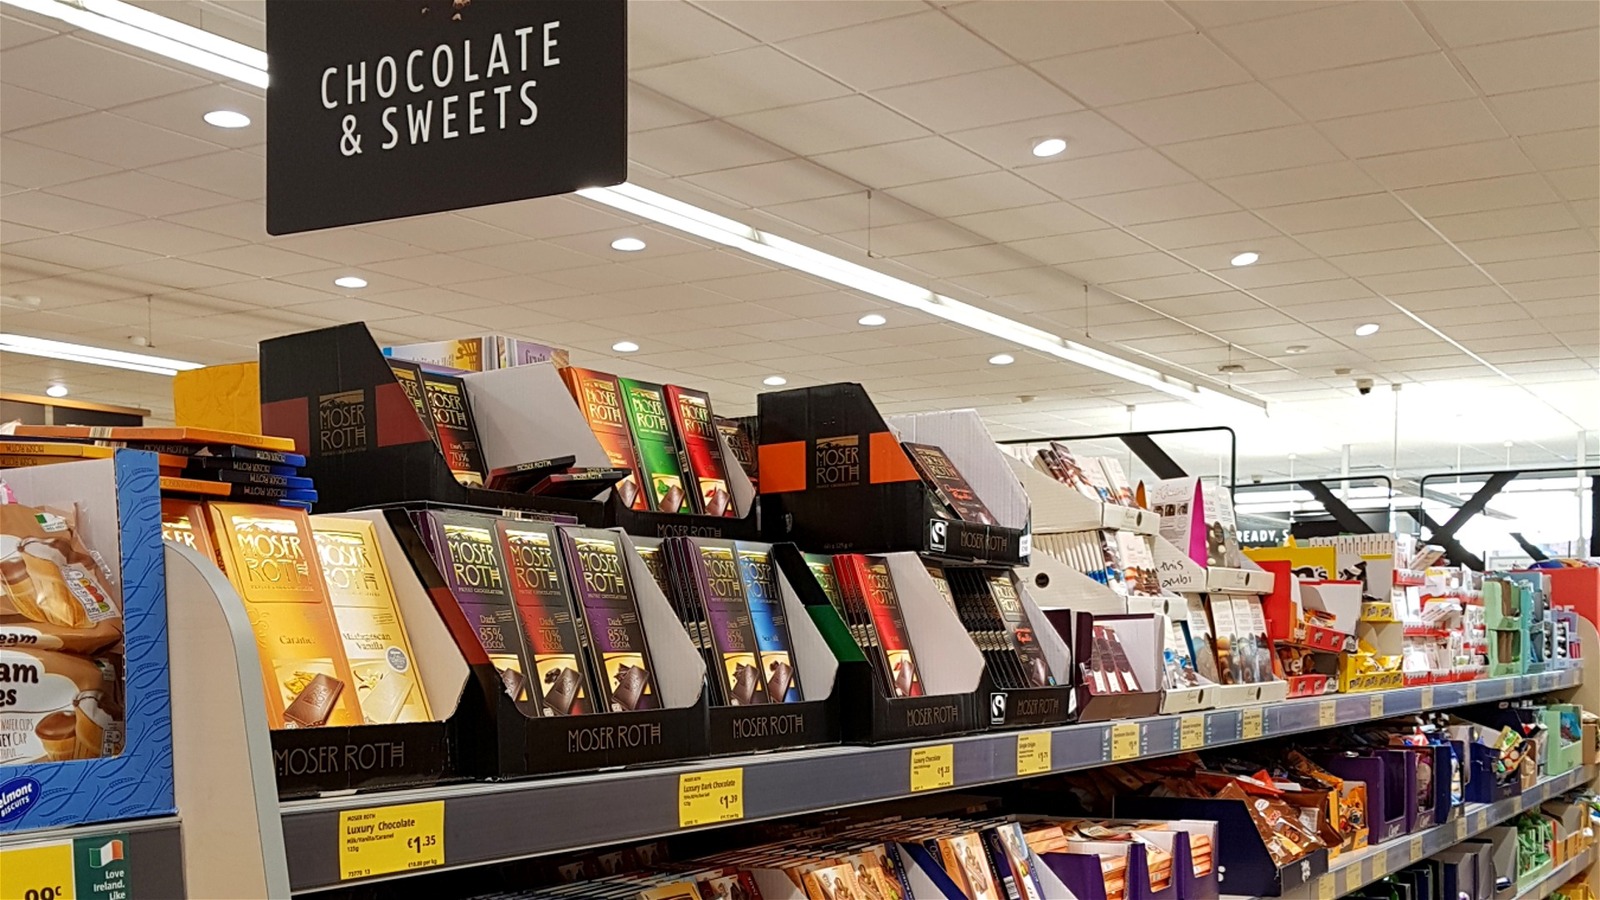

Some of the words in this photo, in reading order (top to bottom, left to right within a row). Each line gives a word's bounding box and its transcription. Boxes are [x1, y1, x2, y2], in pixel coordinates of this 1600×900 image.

[321, 21, 560, 109] CHOCOLATE
[340, 114, 362, 156] &
[381, 80, 538, 150] SWEETS
[428, 392, 463, 410] MOSER
[585, 388, 619, 407] MOSER
[432, 407, 468, 427] ROTH
[589, 403, 623, 423] ROTH
[632, 398, 665, 417] MOSER
[320, 405, 366, 430] MOSER
[636, 413, 669, 431] ROTH
[684, 418, 714, 437] ROTH
[321, 426, 367, 450] ROTH
[816, 447, 859, 467] MOSER
[816, 464, 860, 484] ROTH
[690, 525, 722, 538] ROTH
[960, 531, 985, 550] MOSER
[1236, 530, 1279, 543] READY,
[237, 534, 305, 561] MOSER
[448, 541, 498, 567] MOSER
[510, 545, 556, 568] MOSER
[245, 558, 313, 585] ROTH
[578, 551, 622, 574] MOSER
[703, 559, 738, 579] MOSER
[454, 564, 503, 588] ROTH
[515, 567, 560, 589] ROTH
[583, 572, 627, 594] ROTH
[708, 578, 742, 597] ROTH
[480, 614, 496, 624] Dark
[480, 627, 503, 642] 85%
[539, 629, 561, 642] 70%
[607, 629, 629, 642] 85%
[482, 641, 505, 649] COCOA
[610, 641, 631, 649] COCOA
[907, 707, 933, 727] MOSER
[934, 705, 958, 723] ROTH
[1017, 699, 1038, 716] MOSER
[1039, 698, 1060, 714] ROTH
[19, 718, 34, 731] CUPS
[733, 716, 768, 739] MOSER
[770, 713, 804, 735] ROTH
[568, 726, 614, 753] MOSER
[618, 722, 661, 748] ROTH
[274, 745, 338, 776] MOSER
[345, 741, 405, 771] ROTH
[683, 784, 700, 793] Luxury
[701, 782, 712, 790] Dark
[713, 779, 736, 789] Chocolate
[1, 796, 30, 818] BISCUITS
[347, 824, 375, 835] Luxury
[378, 818, 415, 831] Chocolate
[407, 835, 436, 854] €1.35
[105, 870, 124, 879] Love
[93, 880, 125, 892] Ireland.
